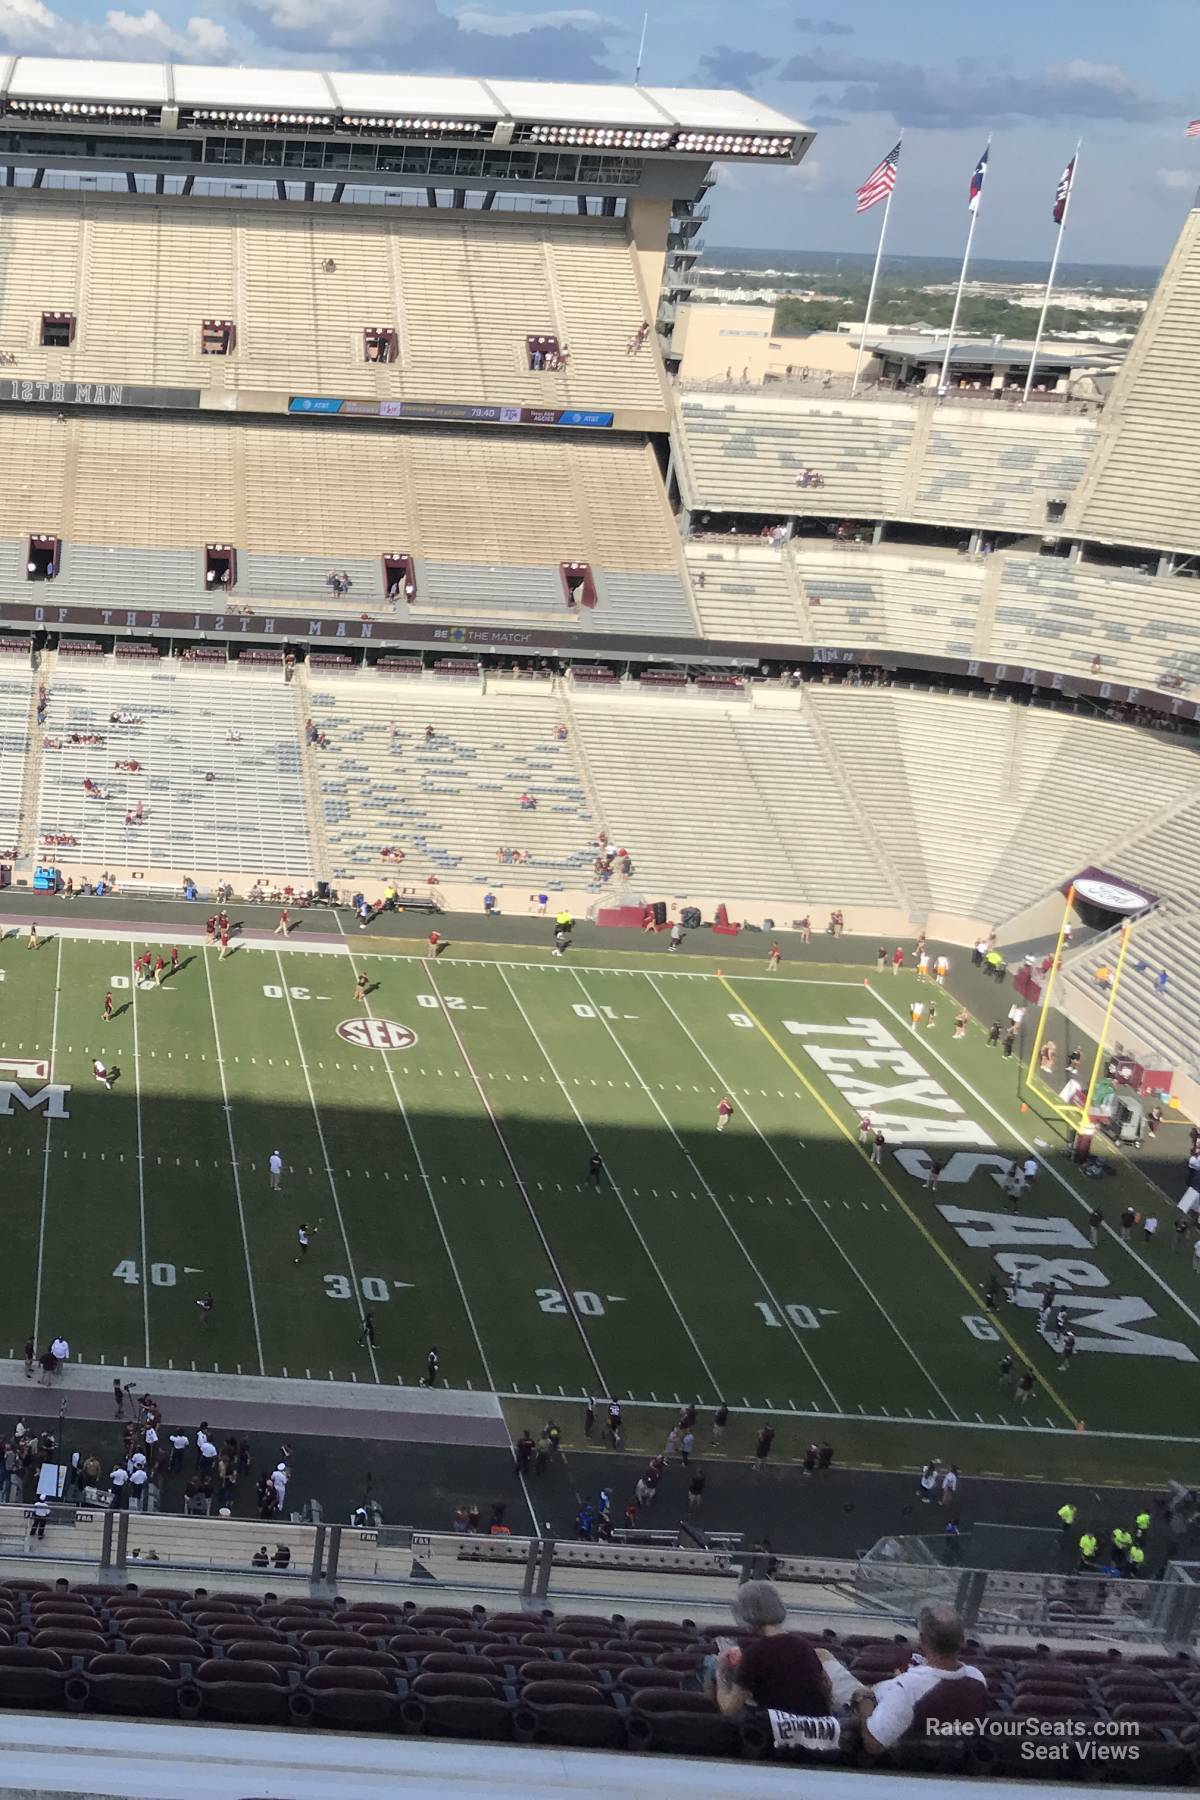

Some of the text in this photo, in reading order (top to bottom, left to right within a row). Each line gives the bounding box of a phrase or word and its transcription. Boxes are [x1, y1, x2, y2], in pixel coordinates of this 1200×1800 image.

[10, 380, 65, 401] 12TH
[75, 383, 124, 404] MAN
[35, 606, 68, 622] OF
[102, 610, 161, 627] THE
[193, 615, 275, 633] 12TH
[308, 621, 373, 638] MAN
[433, 629, 529, 642] BE THE MATCH
[966, 661, 1065, 690] HOME
[1099, 683, 1140, 703] OF
[263, 985, 311, 1000] 30
[417, 995, 467, 1010] 20
[571, 1004, 619, 1019] 10
[341, 1020, 414, 1047] SEC
[782, 1017, 1200, 1362] TEXAS A&M
[112, 1260, 177, 1287] 40
[323, 1274, 391, 1302] 30
[534, 1288, 606, 1316] 20
[753, 1301, 822, 1329] 10
[961, 1315, 1000, 1341] G
